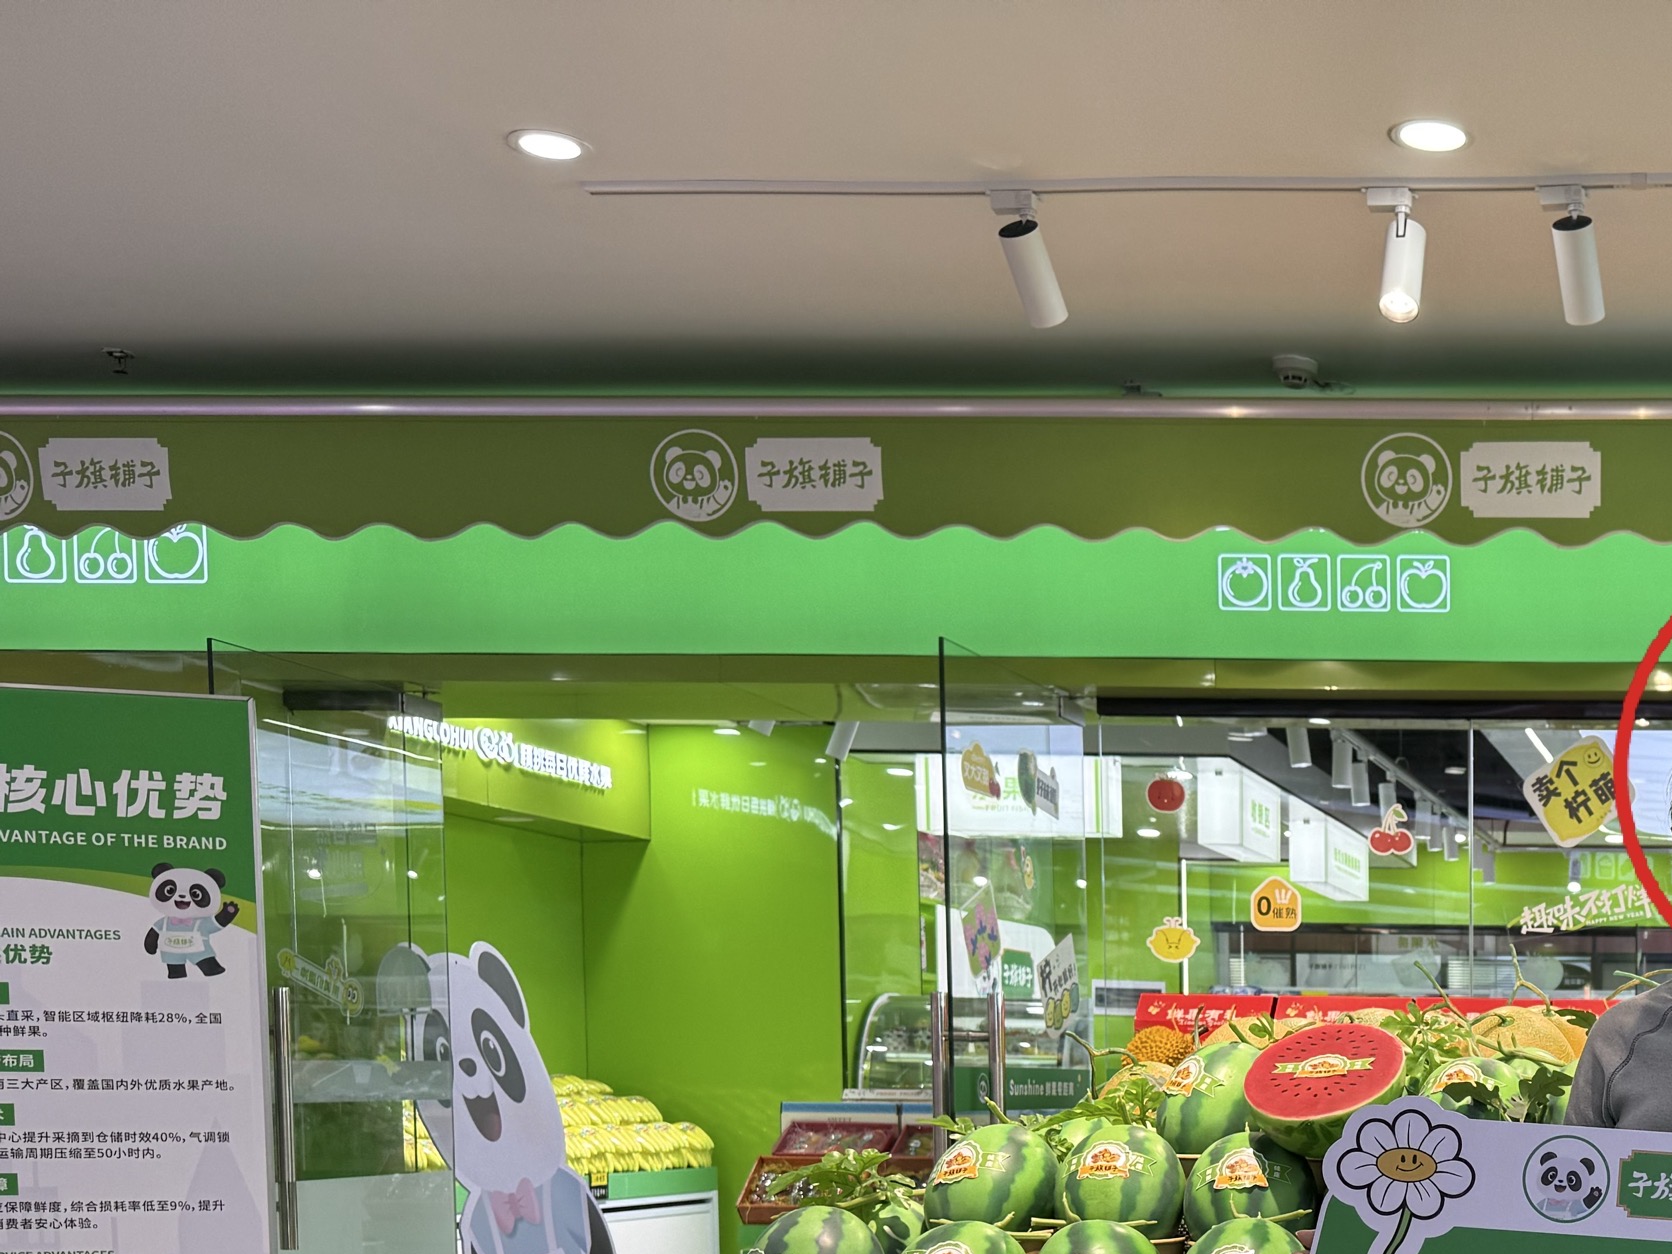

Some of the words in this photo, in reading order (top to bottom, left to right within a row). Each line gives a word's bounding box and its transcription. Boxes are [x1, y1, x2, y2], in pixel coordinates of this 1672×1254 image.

[50, 459, 160, 490] 子旗铺子
[757, 457, 873, 490] 子旗铺子
[1472, 462, 1592, 496] 子旗铺子
[0, 763, 228, 821] 核心优势
[91, 832, 117, 846] OF
[120, 833, 158, 848] THE
[163, 835, 228, 851] BRAND
[28, 928, 121, 941] ADVANTAGES
[0, 943, 53, 966] 优势
[0, 1054, 34, 1068] 布局
